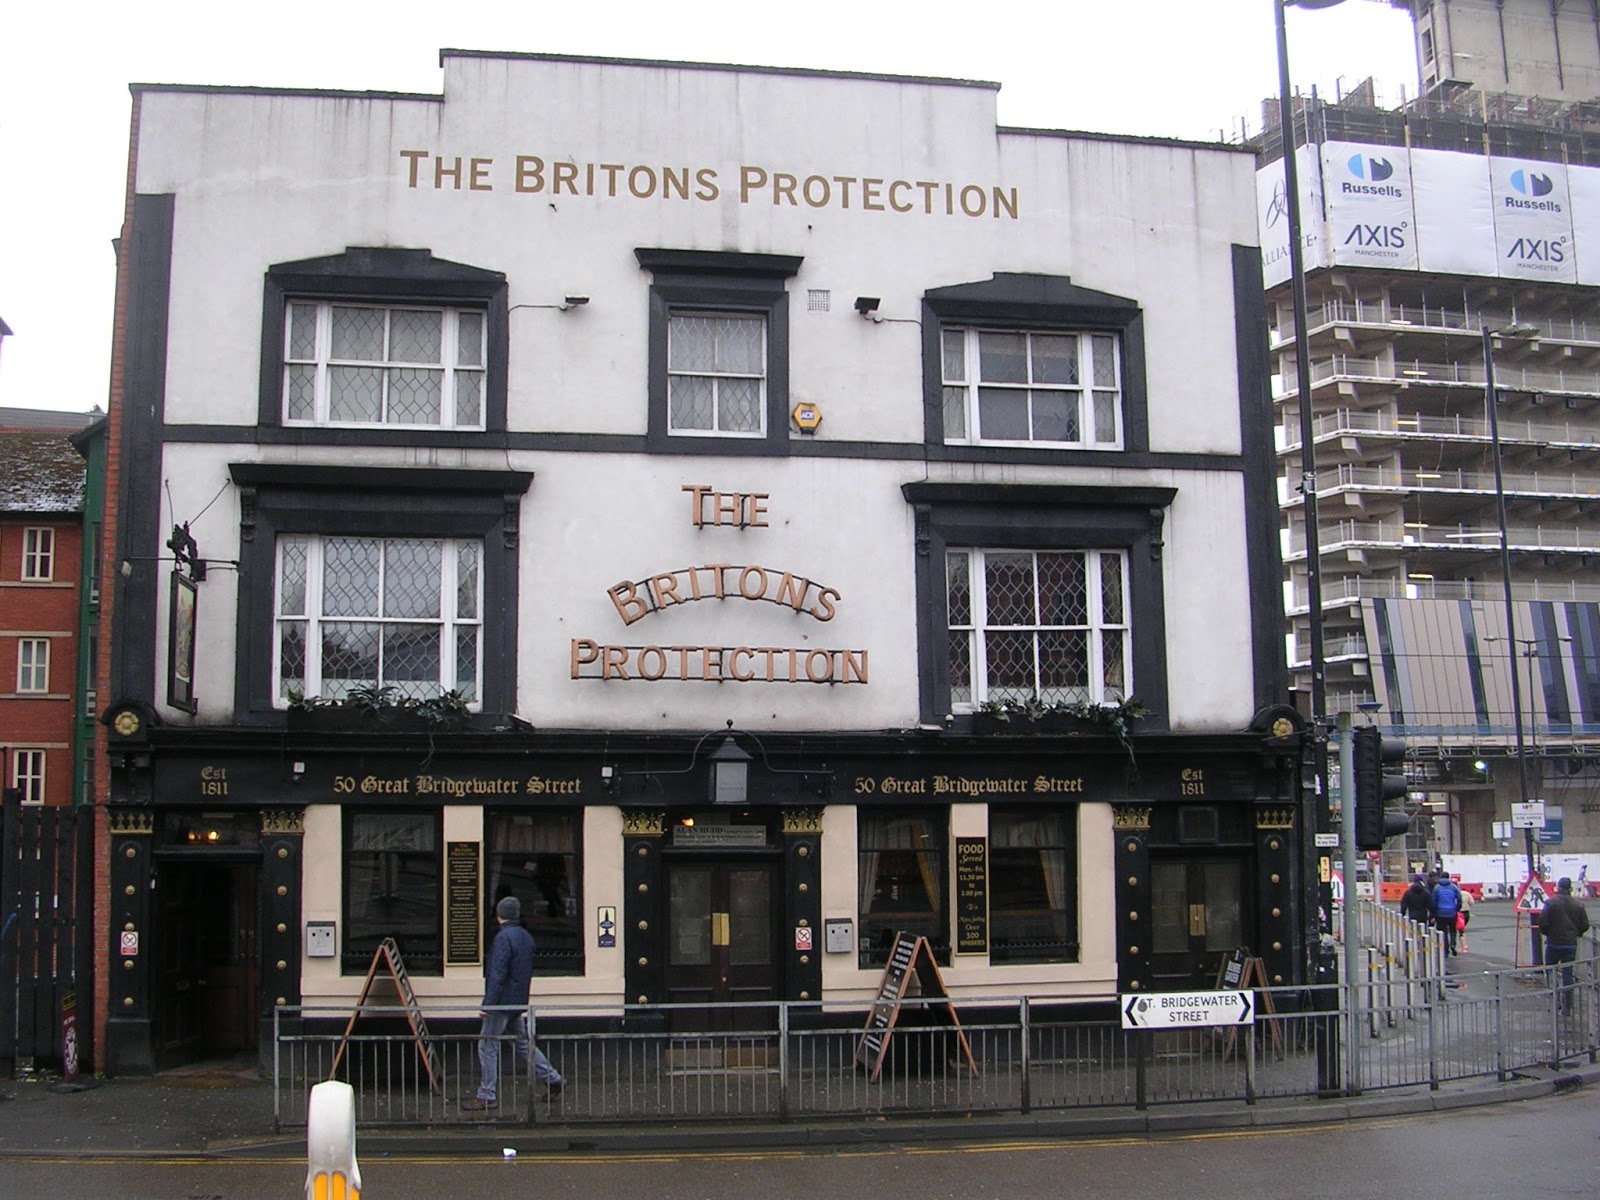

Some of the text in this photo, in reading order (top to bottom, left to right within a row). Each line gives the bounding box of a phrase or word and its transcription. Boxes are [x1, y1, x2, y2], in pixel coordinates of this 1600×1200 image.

[400, 150, 1019, 220] THE BRITONS PROTECTION
[1342, 182, 1402, 198] Russells
[1505, 197, 1561, 213] Russells
[1355, 249, 1400, 258] MANCHESTER
[1517, 263, 1559, 271] MANCHESTER
[681, 485, 770, 527] THE
[607, 563, 841, 626] BRITONS
[571, 638, 868, 684] PROTECTION
[201, 766, 226, 780] Est
[1181, 768, 1203, 781] Est
[201, 781, 228, 795] 1811
[333, 775, 582, 797] 50 Great Bridgewater Street
[854, 775, 1084, 797] 50 Great Bridgewater Street
[1181, 782, 1204, 795] 1811
[958, 844, 984, 854] FOOD
[1161, 995, 1238, 1008] BRIDGEWATER
[1169, 1011, 1209, 1022] STREET
